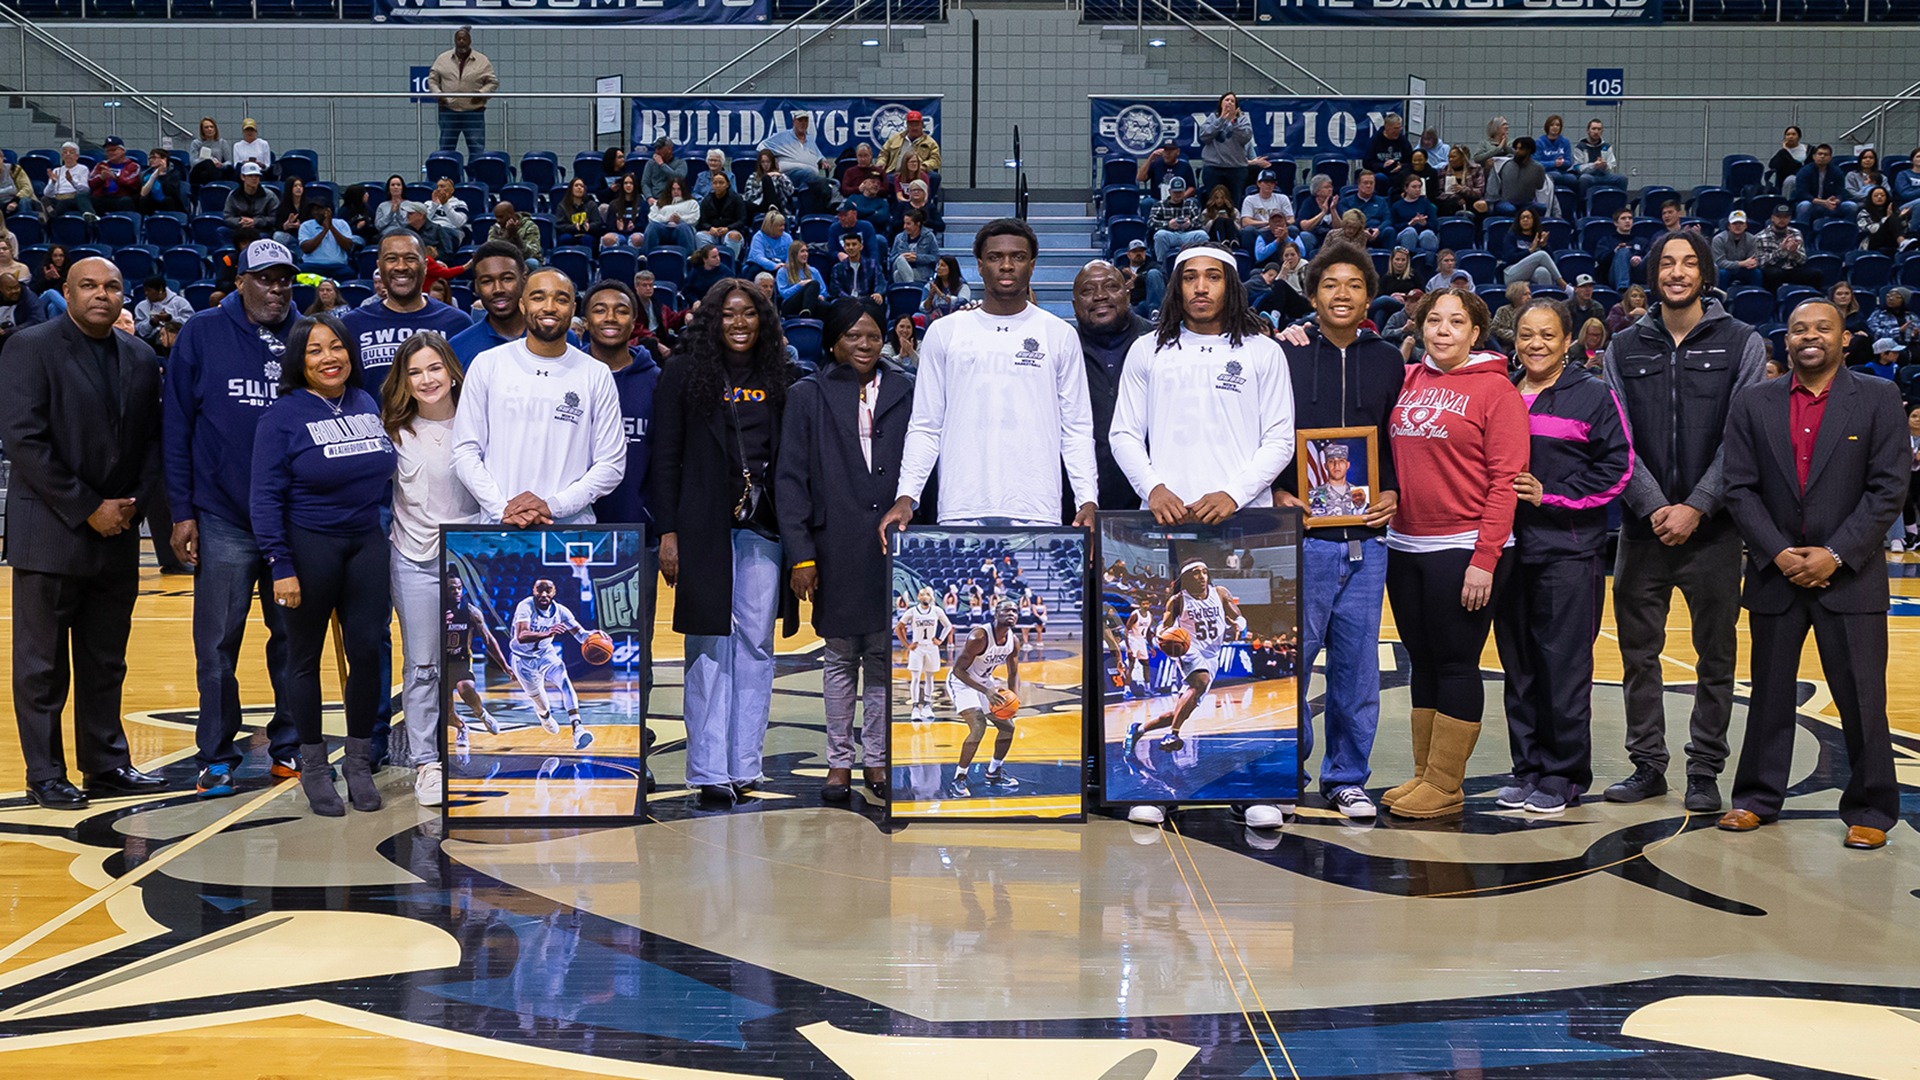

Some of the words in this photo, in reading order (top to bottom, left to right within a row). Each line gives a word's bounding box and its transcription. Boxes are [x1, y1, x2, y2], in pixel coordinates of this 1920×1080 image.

[413, 76, 430, 92] 10
[1589, 79, 1622, 95] 105
[1191, 111, 1397, 148] TIO
[360, 328, 447, 347] SWO
[362, 348, 397, 360] BULLD
[228, 379, 280, 399] SWO
[1426, 424, 1448, 439] Tide
[923, 628, 928, 639] 1
[1195, 619, 1219, 640] 55
